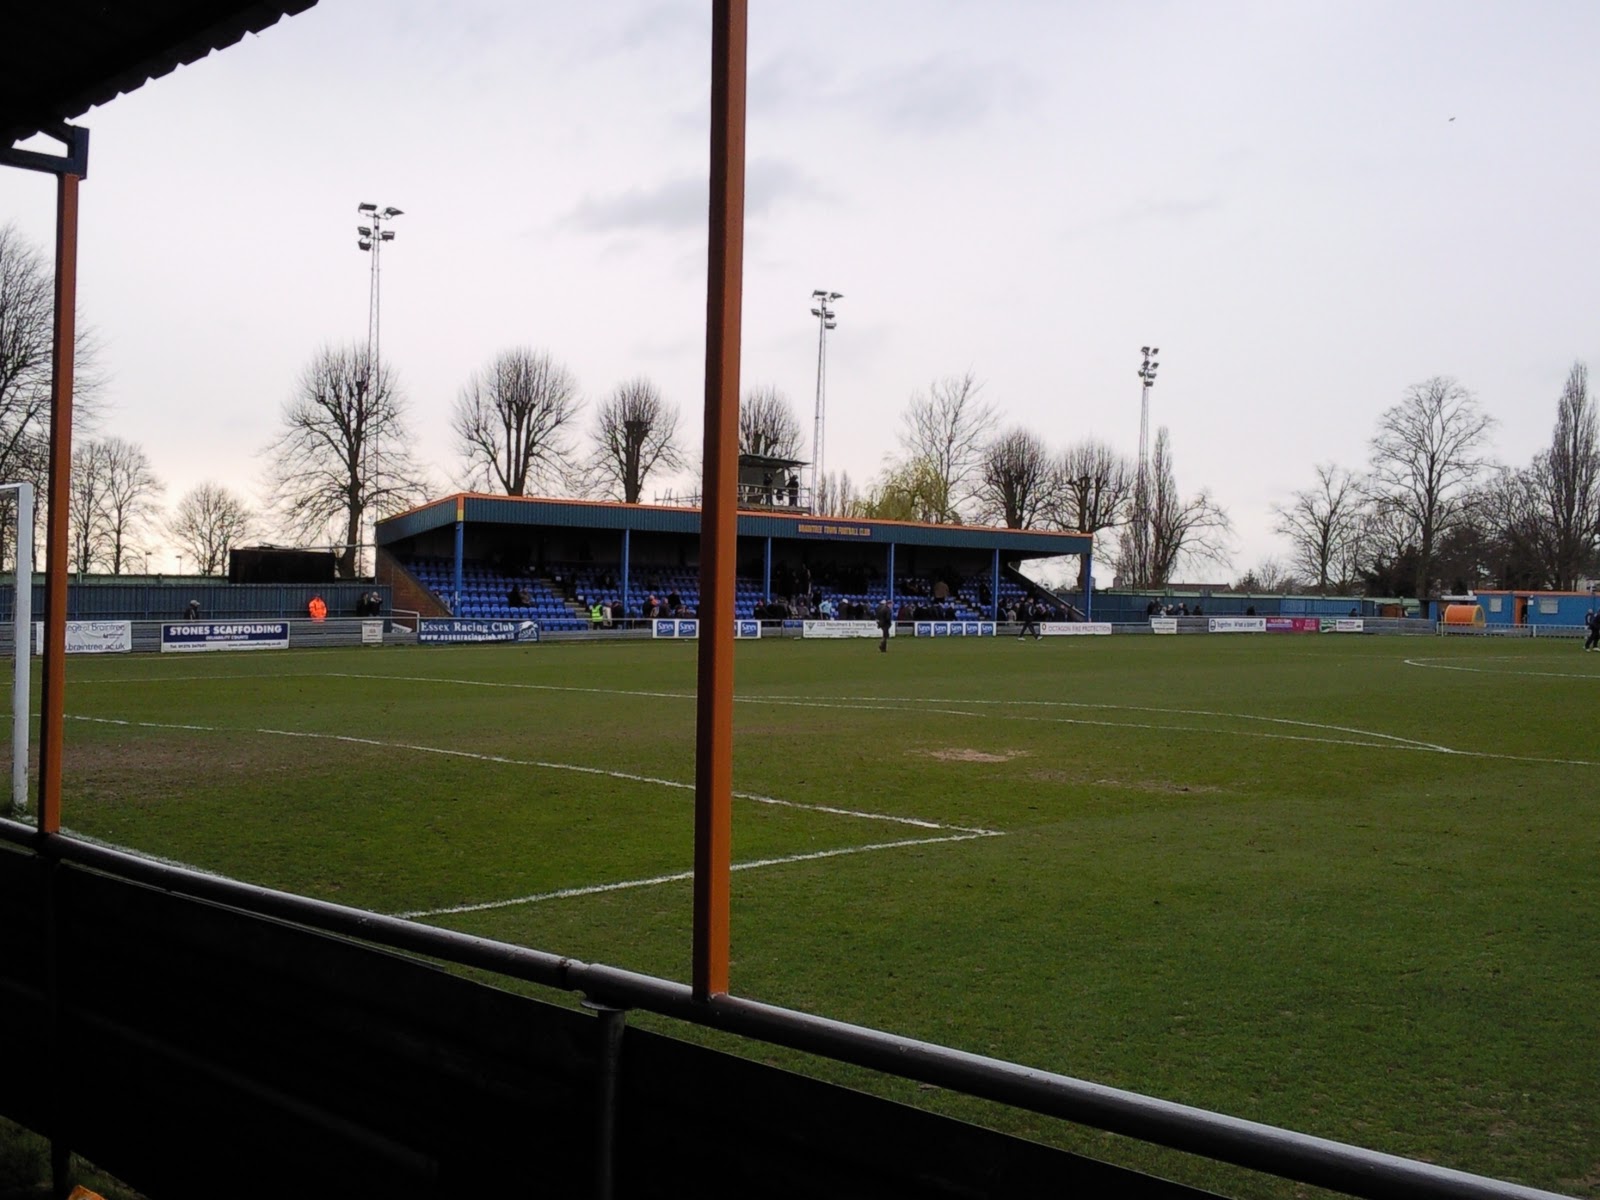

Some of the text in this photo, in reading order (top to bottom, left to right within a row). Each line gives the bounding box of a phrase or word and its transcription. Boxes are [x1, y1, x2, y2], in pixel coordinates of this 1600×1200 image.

[169, 624, 283, 636] STONES SCAFFOLDING
[420, 622, 450, 632] Essex
[453, 621, 489, 633] Racing
[491, 621, 515, 632] Club
